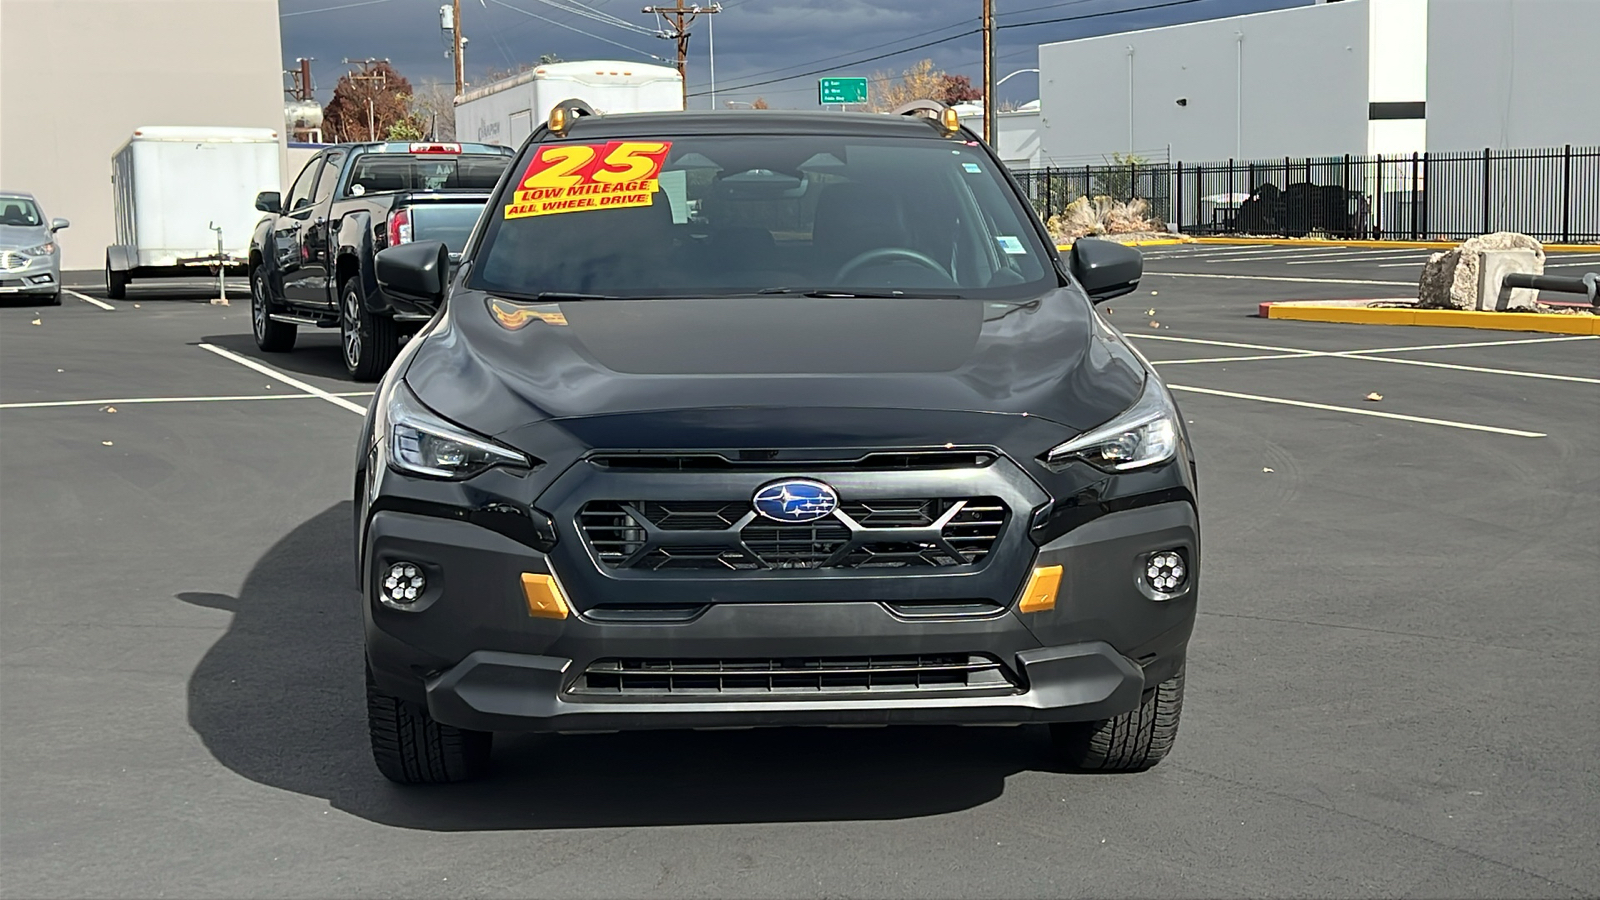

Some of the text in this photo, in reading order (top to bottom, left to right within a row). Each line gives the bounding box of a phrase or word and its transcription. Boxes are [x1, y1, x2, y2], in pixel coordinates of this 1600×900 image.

[524, 143, 667, 188] 25
[521, 180, 649, 201] LOW MILEAGE
[508, 194, 647, 215] ALL WHEEL DRIVE
